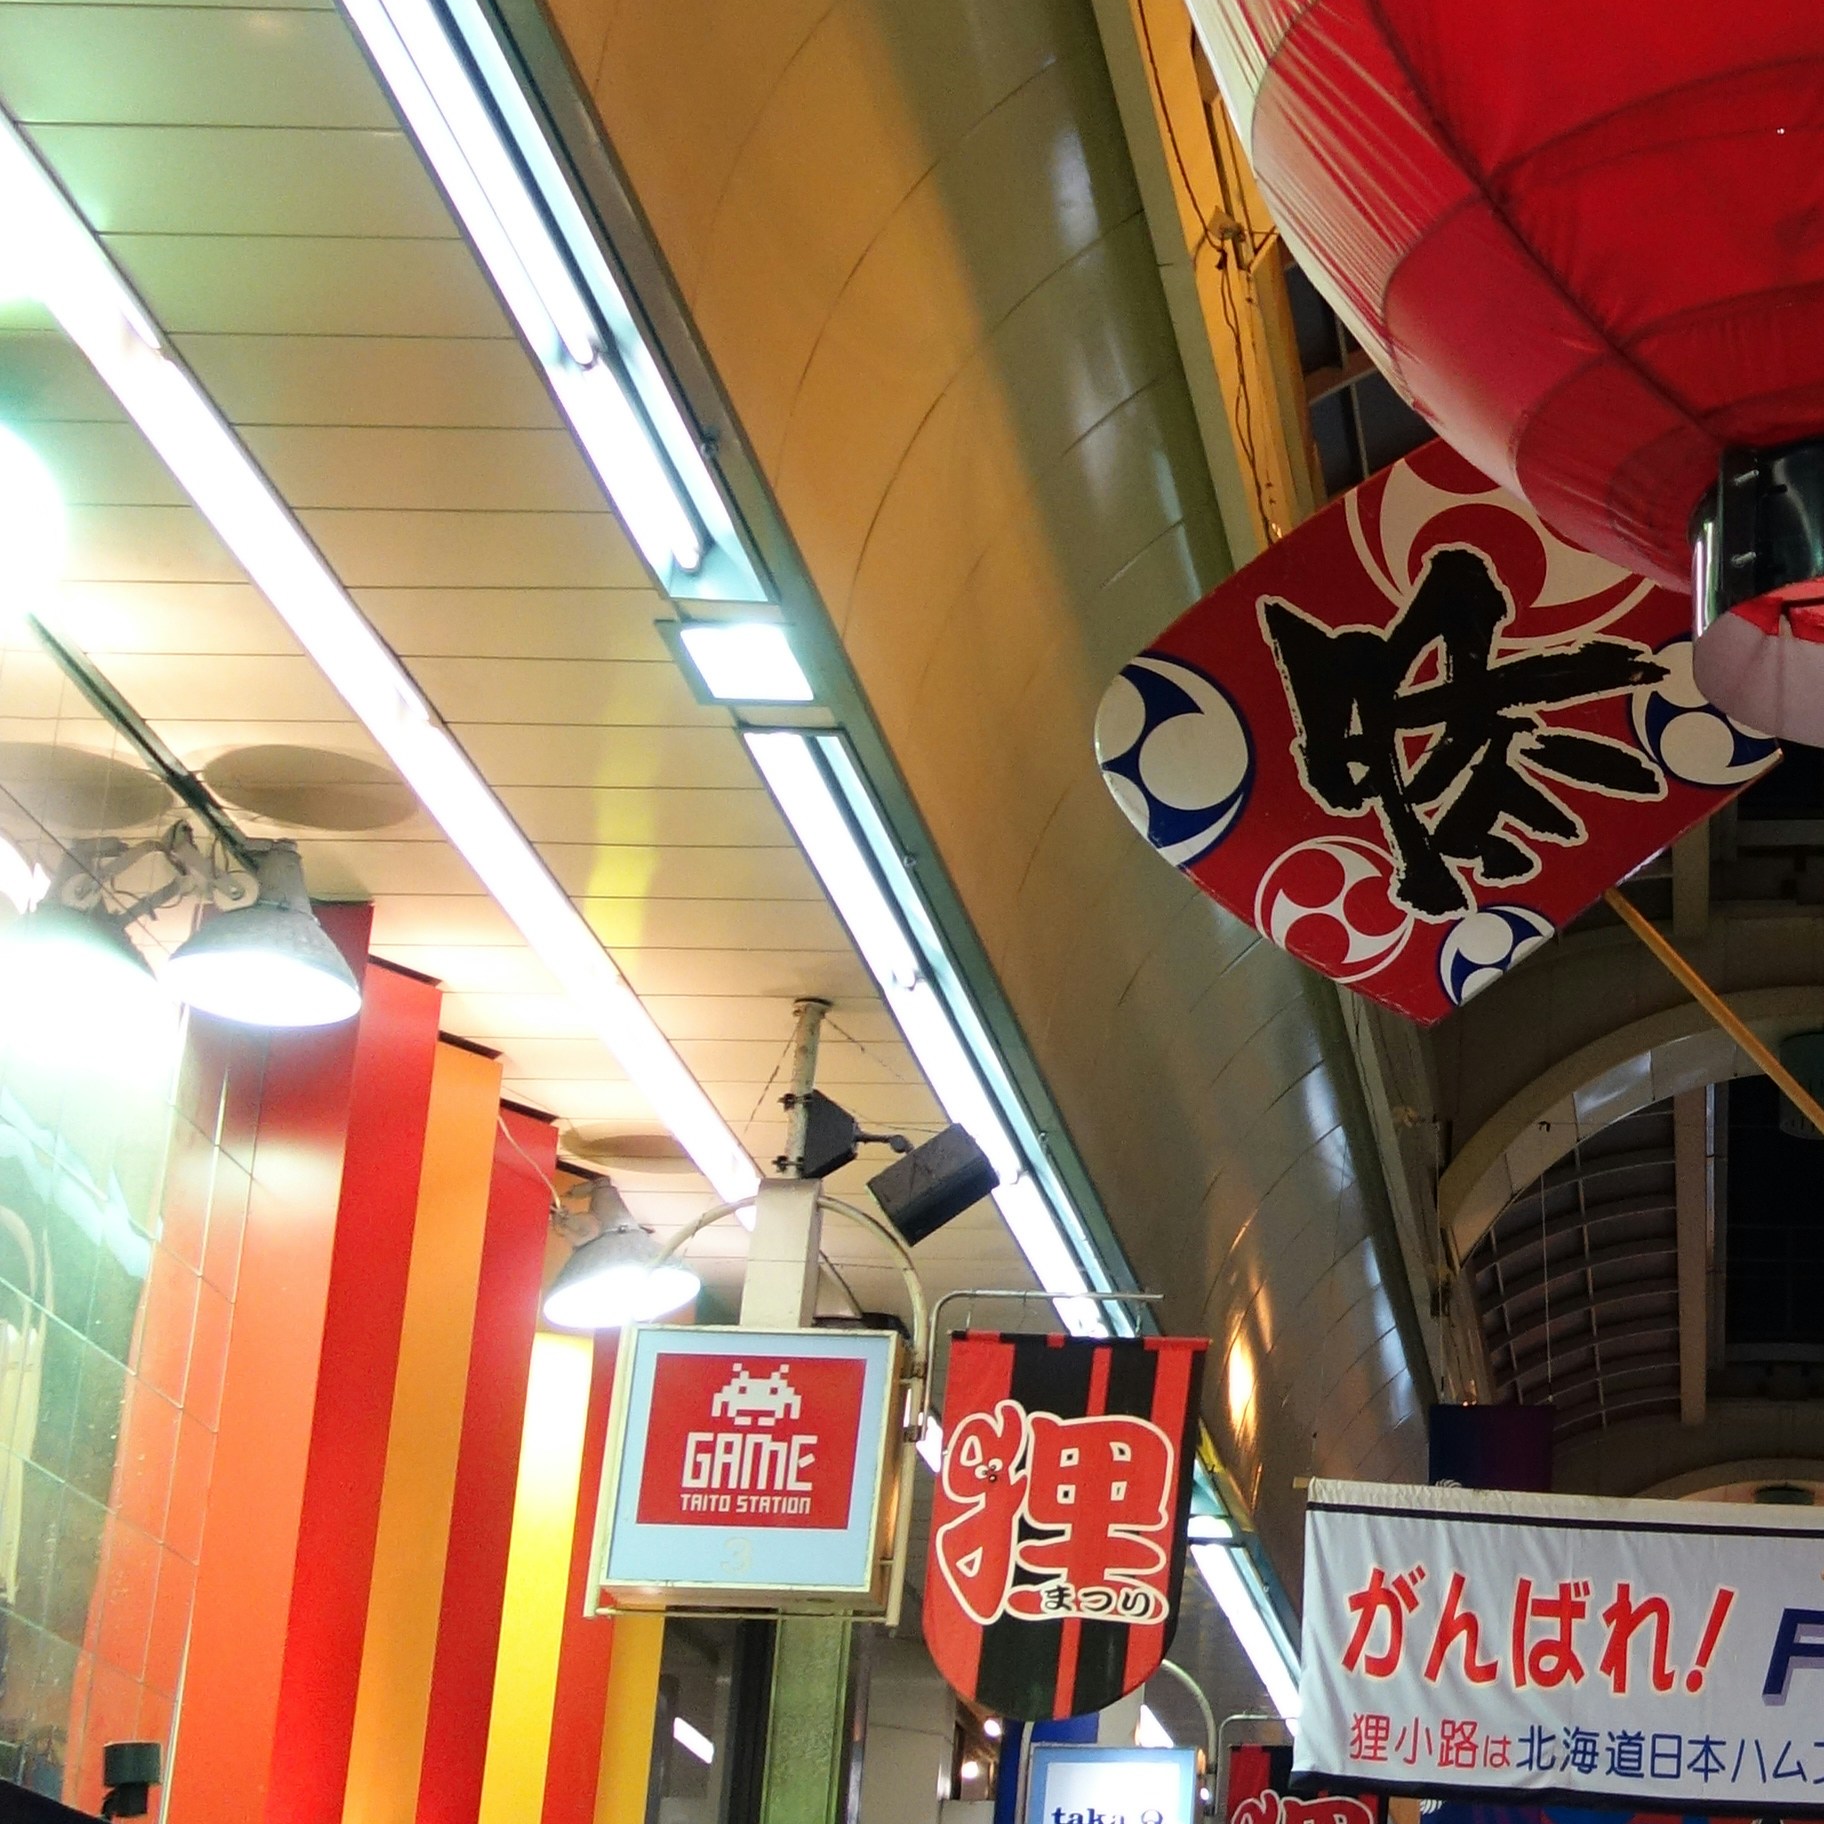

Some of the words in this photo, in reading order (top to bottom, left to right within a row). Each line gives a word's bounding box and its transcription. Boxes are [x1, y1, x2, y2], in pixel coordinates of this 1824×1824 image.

[1258, 542, 1670, 924] 祭
[681, 1432, 818, 1491] GAME
[680, 1493, 731, 1513] TAITO
[735, 1495, 811, 1515] STATION
[721, 1537, 752, 1574] 3
[1042, 1585, 1152, 1613] まつり
[1341, 1563, 1736, 1695] がんばれ!
